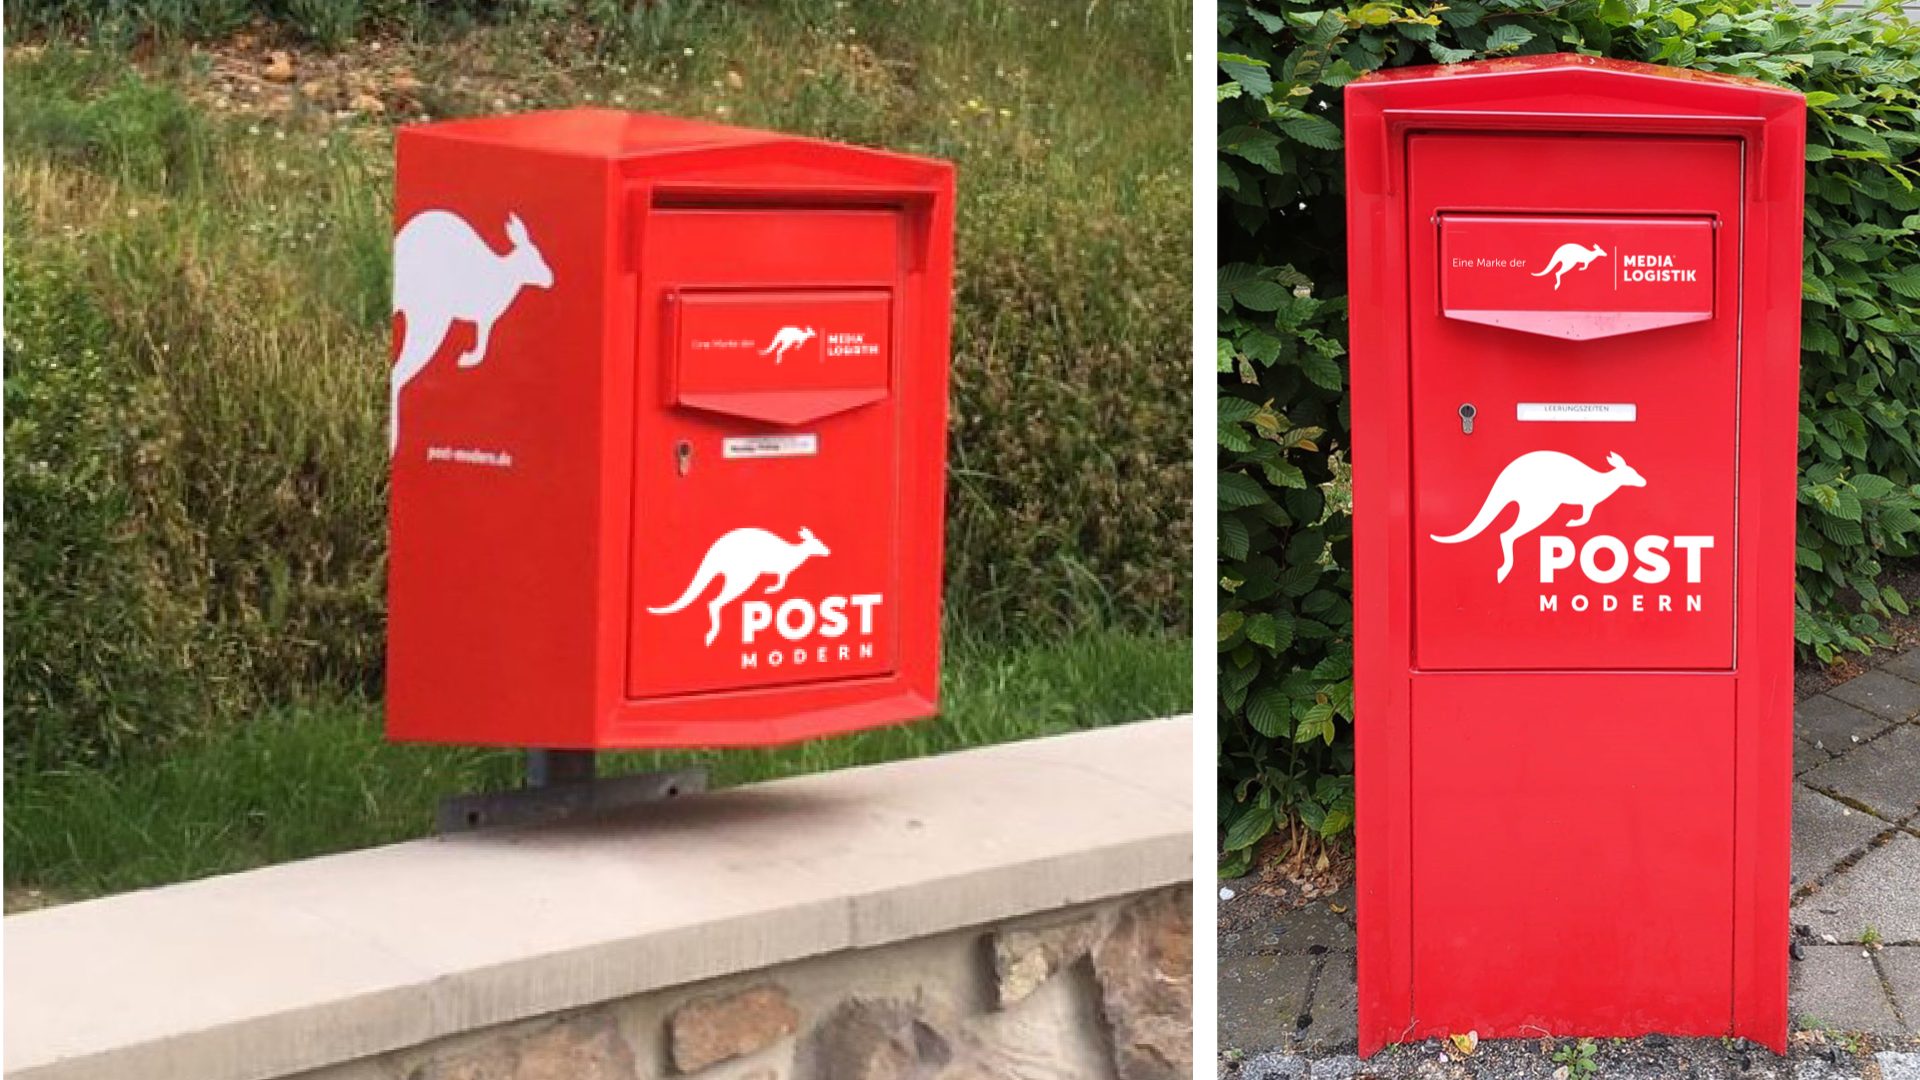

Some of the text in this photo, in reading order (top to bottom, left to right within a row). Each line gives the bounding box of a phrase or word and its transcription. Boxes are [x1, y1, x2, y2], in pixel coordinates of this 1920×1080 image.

[1452, 258, 1526, 268] Eine Marke der
[1623, 255, 1674, 267] MEDIA
[1623, 269, 1697, 282] LOGISTIK
[1539, 534, 1715, 585] POST
[1539, 594, 1702, 613] MODERN
[741, 592, 884, 645] POST
[740, 642, 874, 669] MODERN
